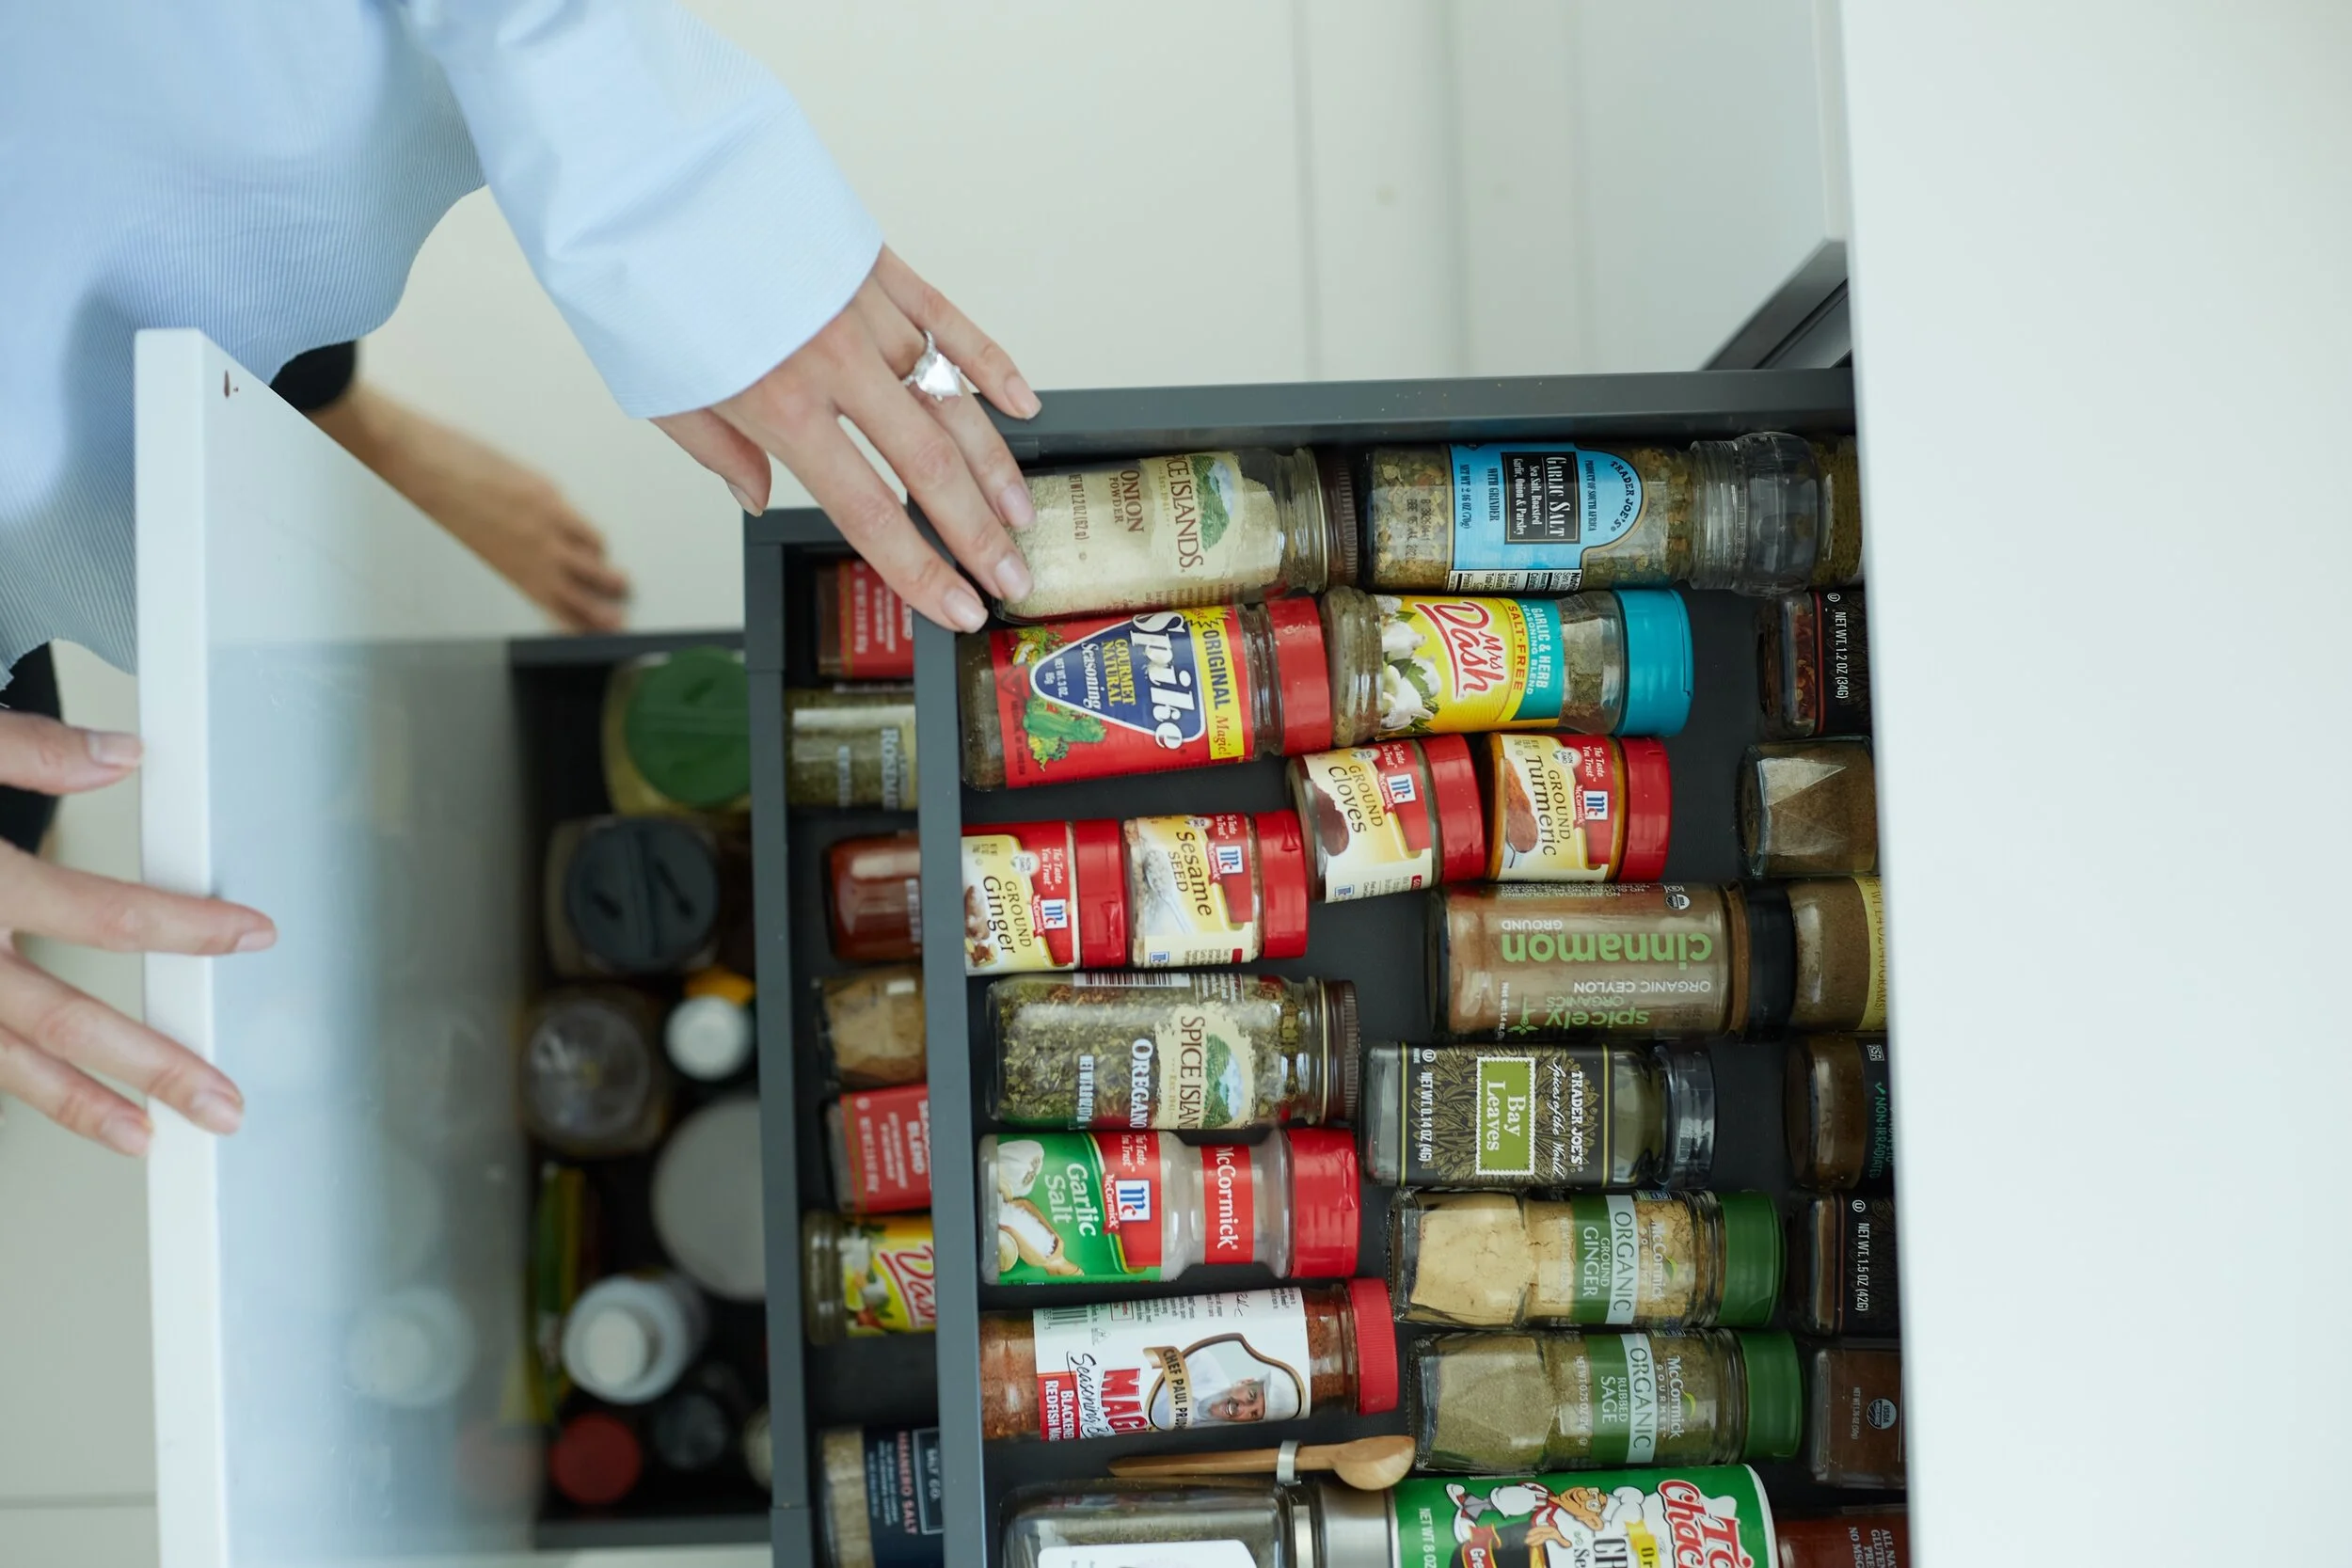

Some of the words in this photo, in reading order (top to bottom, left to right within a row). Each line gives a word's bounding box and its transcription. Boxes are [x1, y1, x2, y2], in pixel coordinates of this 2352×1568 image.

[1165, 456, 1189, 478] ICE
[1459, 465, 1470, 475] NET
[1461, 476, 1470, 485] WT
[1487, 468, 1498, 485] WITH
[1530, 466, 1540, 477] Sea
[1584, 460, 1596, 482] PRODUCT
[1610, 461, 1635, 496] TRADER
[1070, 483, 1084, 494] WT
[1109, 477, 1123, 523] POWDER
[1120, 470, 1144, 532] ONION
[1488, 487, 1500, 521] GRINDER
[1516, 479, 1525, 498] Onion
[1587, 490, 1597, 508] SOUTH
[1073, 506, 1087, 515] OZ
[1169, 480, 1203, 569] ISLANDS
[1514, 508, 1527, 535] Parsley
[1532, 495, 1542, 525] Roasted
[1587, 509, 1597, 531] AFRICA
[1613, 499, 1633, 529] JOE'S
[1520, 605, 1538, 656] SEASONING
[1532, 608, 1550, 641] GARLIC
[1835, 611, 1847, 628] NET
[1433, 602, 1504, 691] Dash
[1479, 631, 1504, 669] Mrs
[1836, 647, 1847, 660] 1.2
[1054, 657, 1065, 671] NET
[1080, 642, 1104, 709] Seasoning
[1102, 640, 1121, 706] NATURAL
[1114, 639, 1136, 705] GOURMET
[1129, 612, 1195, 750] Spike
[1202, 630, 1231, 709] ORIGINAL
[1526, 659, 1537, 694] BLEND
[1536, 656, 1550, 688] HERB
[1836, 662, 1848, 673] OZ
[1836, 676, 1849, 699] (34G)
[1213, 715, 1231, 755] Magic!
[1582, 746, 1592, 756] You
[1594, 747, 1604, 757] The
[1585, 758, 1594, 777] Trust
[1597, 758, 1605, 778] Taste
[1327, 766, 1367, 833] Cloves
[1349, 766, 1383, 827] GROUND
[1377, 773, 1393, 808] McCormick
[1525, 755, 1560, 855] Turmeric
[1548, 769, 1571, 840] GROUND
[1575, 784, 1584, 825] McCormick
[1041, 848, 1052, 863] You
[1053, 848, 1062, 860] The
[1207, 843, 1221, 879] McCormick
[1042, 864, 1053, 885] Trust
[1054, 863, 1063, 884] Taste
[1168, 851, 1189, 892] SEED
[1176, 832, 1212, 915] Sesame
[983, 876, 1015, 953] Ginger
[1005, 881, 1032, 947] GROUND
[1033, 894, 1044, 934] McCormick
[1501, 919, 1562, 930] GROUND
[1501, 933, 1712, 970] cinnamon
[1546, 996, 1625, 1006] ORGANICS
[1573, 980, 1635, 993] CEYLON
[1640, 980, 1710, 993] ORGANIC
[1545, 1007, 1650, 1029] spicely
[1180, 1016, 1205, 1077] SPICE
[1130, 1038, 1153, 1128] OREGANO
[1420, 1072, 1433, 1088] NET
[1547, 1057, 1566, 1099] Spices
[1177, 1085, 1204, 1129] ISLAN
[1570, 1070, 1582, 1124] TRADER
[1420, 1108, 1433, 1129] 0.14
[1486, 1081, 1505, 1151] Leaves
[1504, 1095, 1526, 1136] Bay
[1418, 1144, 1433, 1161] (4G)
[1420, 1130, 1433, 1142] OZ
[1571, 1127, 1582, 1164] JOE'S
[1121, 1146, 1134, 1166] Trust
[1136, 1145, 1147, 1166] Taste
[1551, 1141, 1565, 1180] World
[1043, 1174, 1073, 1223] Salt
[1066, 1164, 1100, 1236] Garlic
[1104, 1174, 1119, 1228] McCormick
[1215, 1147, 1239, 1249] McCormick
[1856, 1223, 1869, 1239] NET
[1582, 1227, 1600, 1297] GINGER
[1599, 1237, 1611, 1287] GROUND
[1613, 1212, 1634, 1311] ORGANIC
[1651, 1222, 1666, 1302] McCormick
[1856, 1259, 1868, 1273] 1.5
[1856, 1275, 1868, 1286] OZ
[1855, 1289, 1868, 1311] (42G)
[1163, 1349, 1184, 1374] CHEF
[1575, 1355, 1586, 1368] NET
[1578, 1369, 1587, 1384] WT
[1045, 1380, 1060, 1428] REDFISH
[1071, 1354, 1103, 1423] Seasoning
[1171, 1379, 1187, 1405] PAUL
[1600, 1376, 1617, 1423] SAGE
[1617, 1377, 1629, 1422] RUBBED
[1629, 1348, 1652, 1449] ORGANIC
[1657, 1364, 1666, 1433] GOURMET
[1667, 1355, 1684, 1439] McCormick
[902, 1500, 917, 1534] SALT
[1419, 1508, 1435, 1525] NET
[1422, 1527, 1435, 1543] WT
[1848, 1528, 1858, 1542] NO
[1882, 1529, 1893, 1547] ALL
